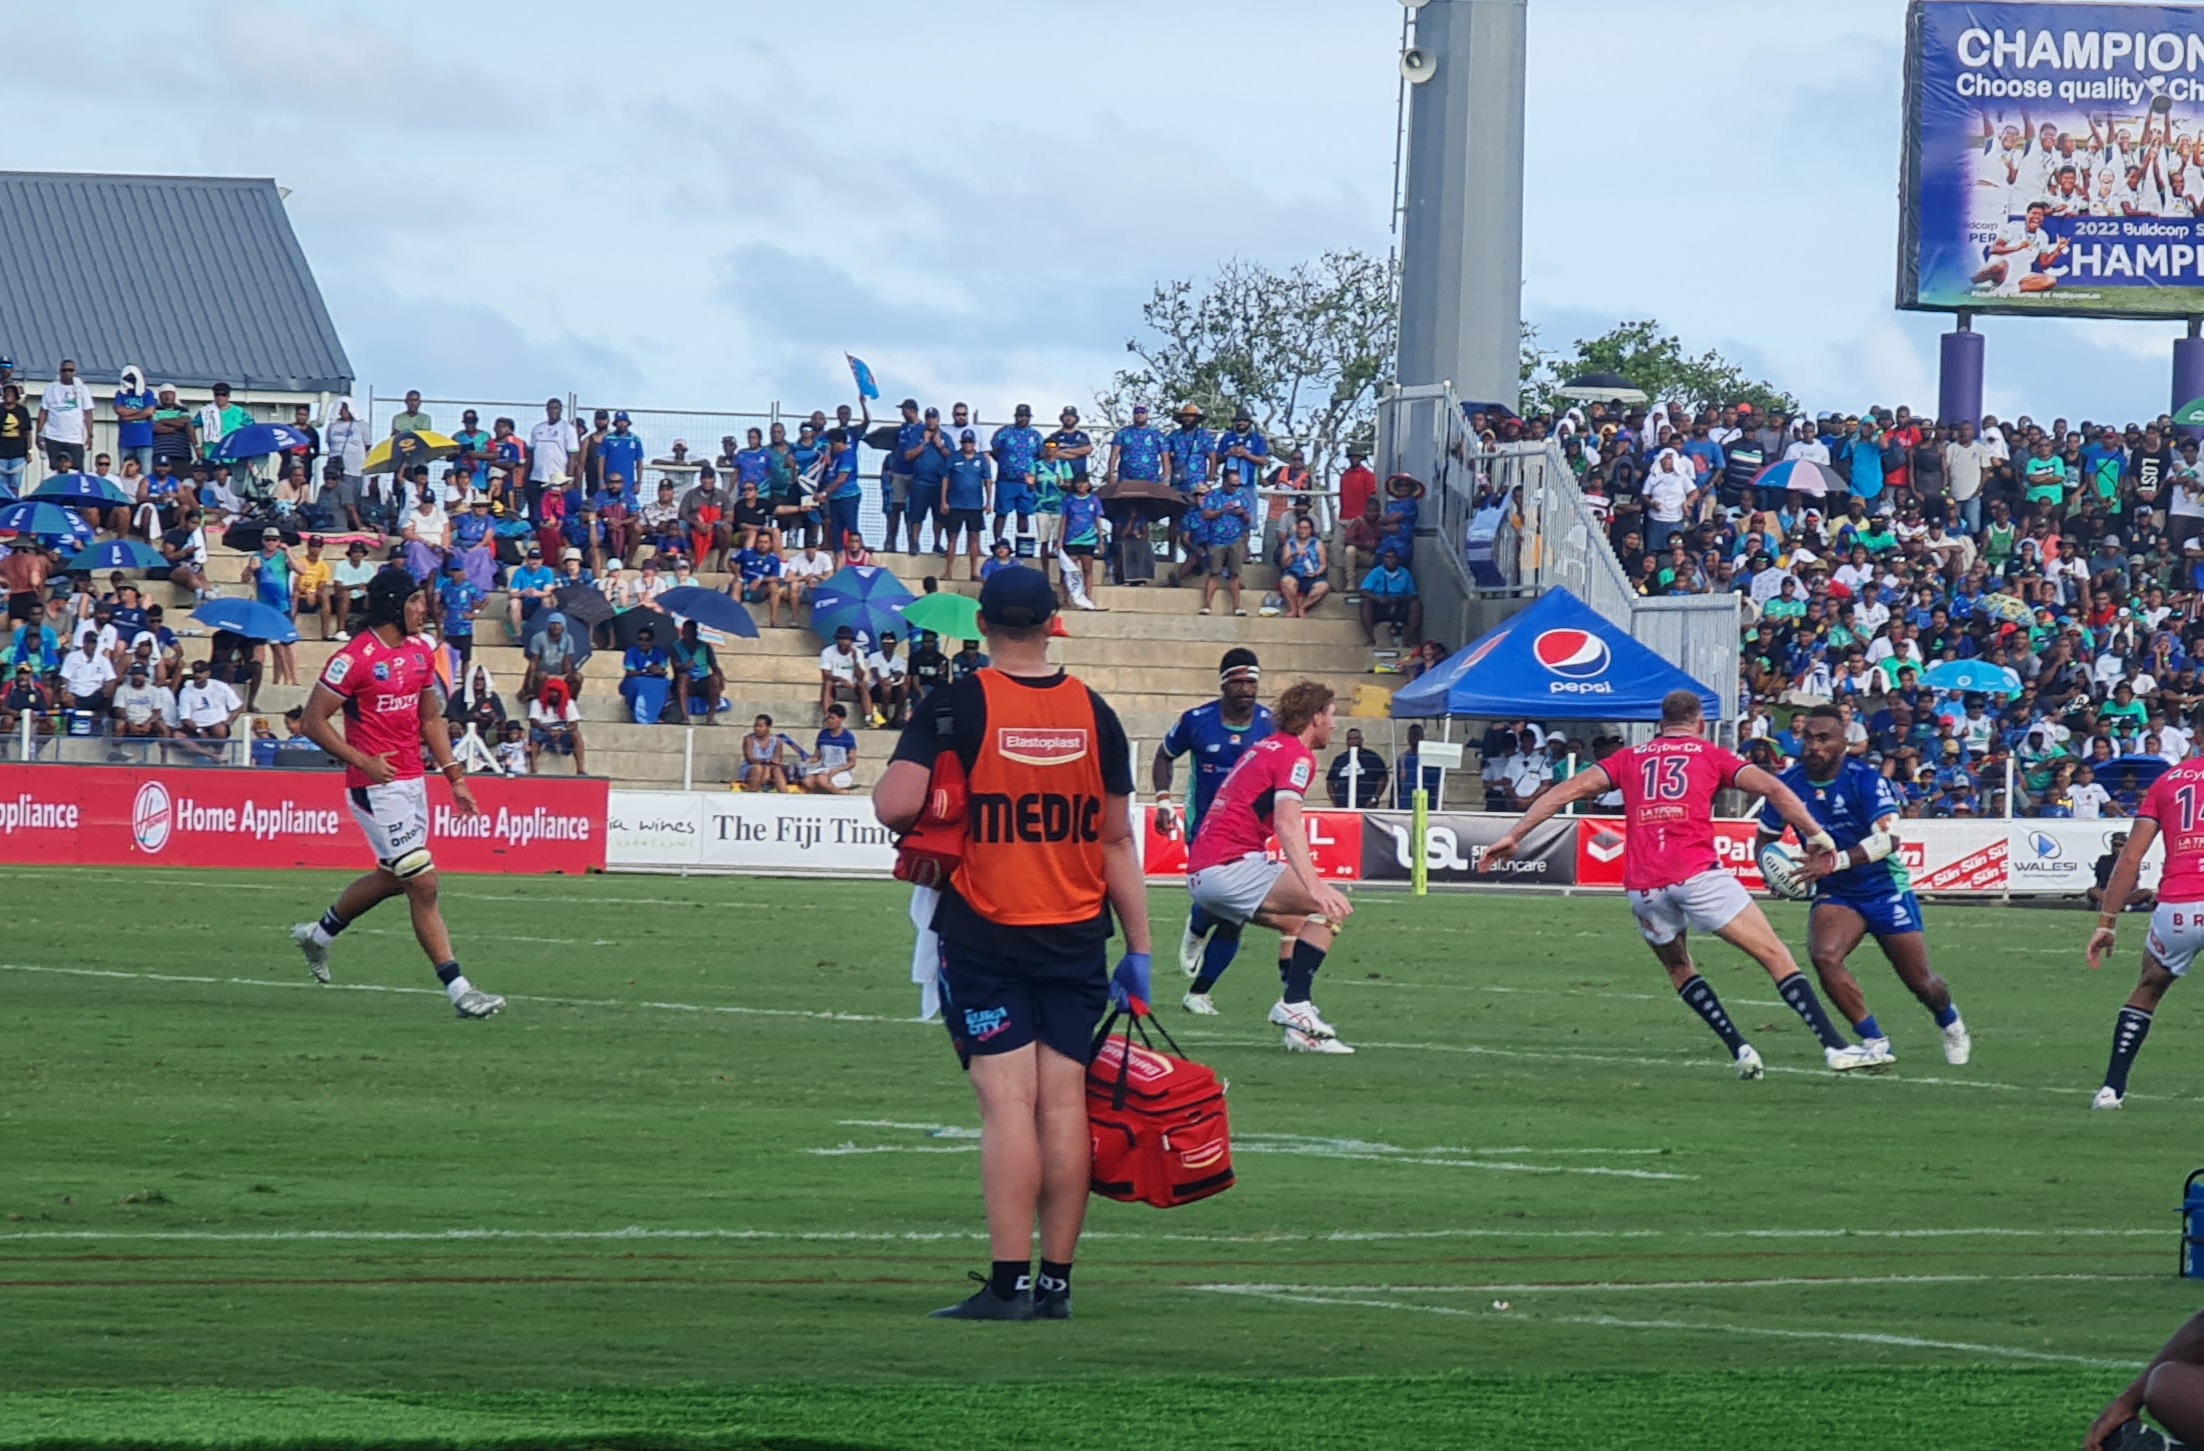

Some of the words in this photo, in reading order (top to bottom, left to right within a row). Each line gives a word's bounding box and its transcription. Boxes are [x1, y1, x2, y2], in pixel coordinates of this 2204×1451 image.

[1956, 72, 2053, 98] Choose
[2058, 76, 2145, 105] quality
[2168, 77, 2204, 102] Ch
[2074, 221, 2120, 236] 2022
[2122, 222, 2190, 239] Buildcorp
[1550, 680, 1612, 695] pepsi
[1005, 735, 1081, 750] Elastoplast
[1641, 754, 1691, 800] 13
[176, 798, 236, 832] Home
[240, 799, 339, 841] Appliance
[433, 804, 491, 838] Home
[494, 806, 590, 846] Appliance
[970, 792, 1101, 843] MEDIC
[2175, 783, 2204, 833] 1
[639, 817, 695, 835] wines
[712, 814, 767, 842] The
[774, 816, 822, 850] Fiji
[829, 818, 898, 845] Time
[2013, 861, 2078, 872] WALESI
